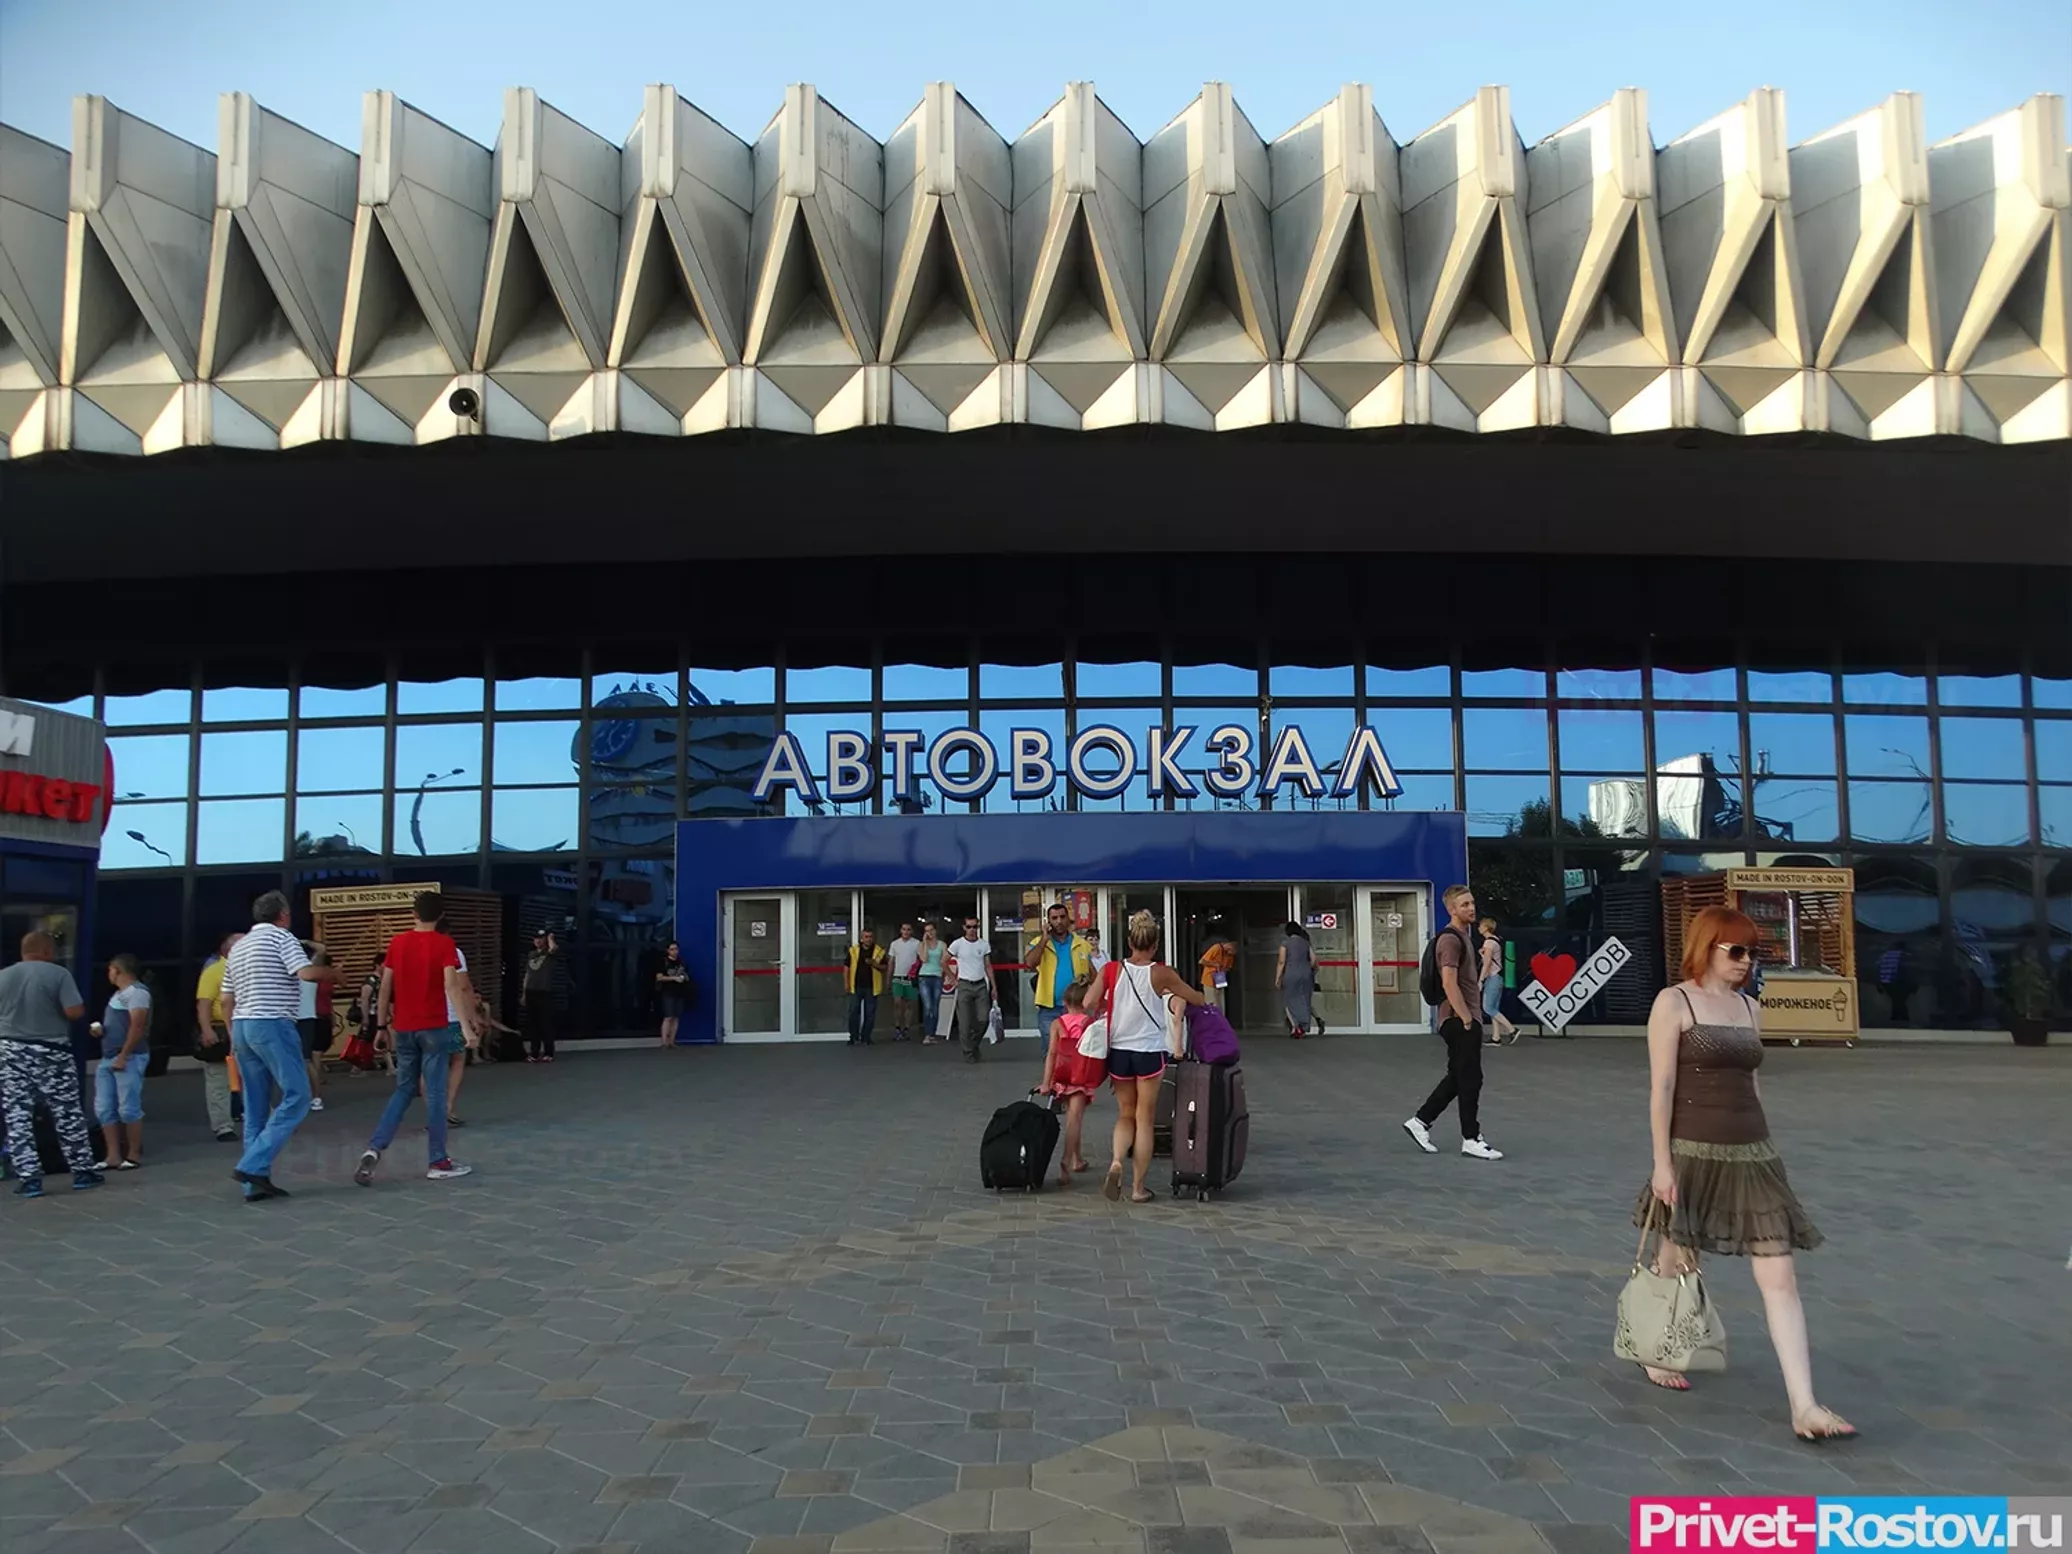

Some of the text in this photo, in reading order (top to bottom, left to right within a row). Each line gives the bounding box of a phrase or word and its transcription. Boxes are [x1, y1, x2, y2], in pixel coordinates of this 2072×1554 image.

[751, 723, 1404, 803] АВТОВОКЗАЛ
[1736, 873, 1845, 884] MADE IN ROSTOV-ON-DON
[319, 894, 345, 904] MADE
[347, 893, 356, 903] IN
[1543, 943, 1626, 1029] РОСТОВ
[1526, 988, 1550, 1010] Я
[1760, 997, 1833, 1010] МОРОЖЕНОЕ
